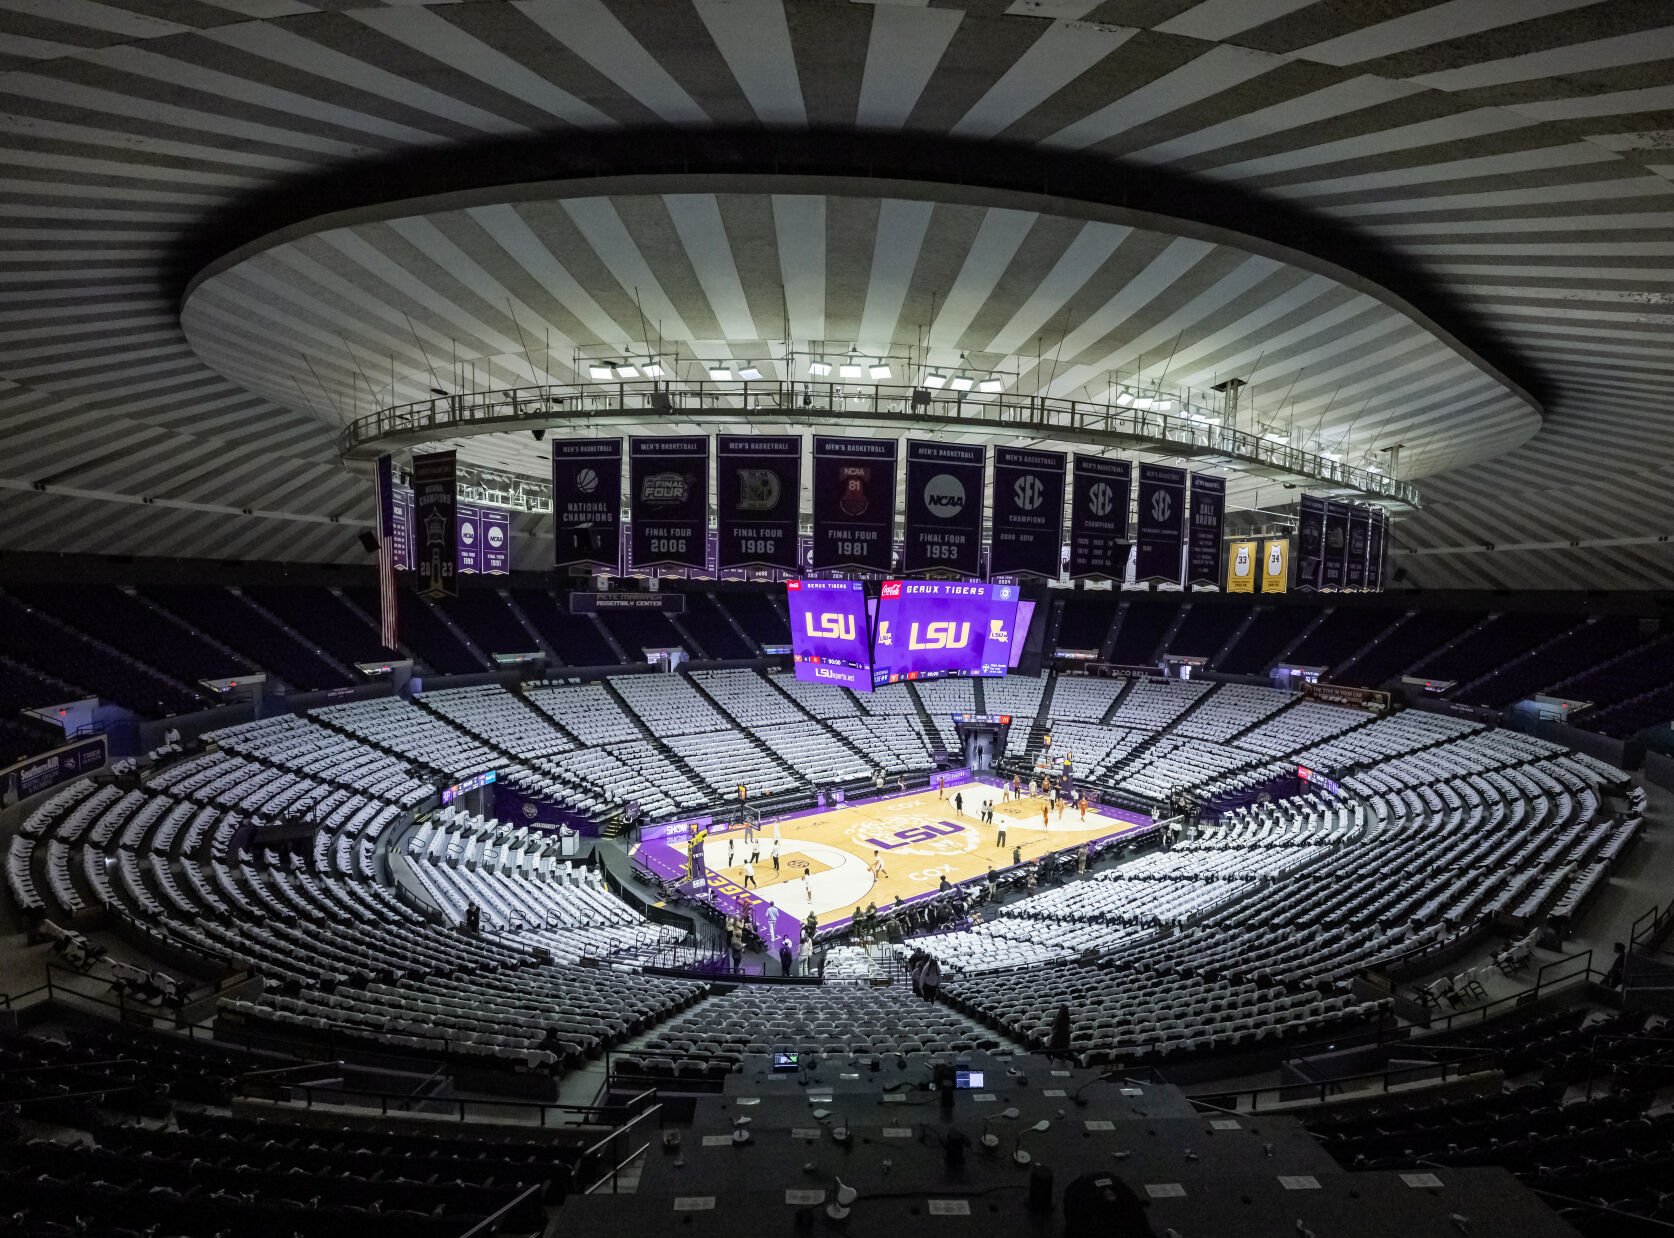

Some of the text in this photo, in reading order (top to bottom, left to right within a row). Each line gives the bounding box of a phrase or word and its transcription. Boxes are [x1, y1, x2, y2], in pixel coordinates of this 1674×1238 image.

[563, 445, 612, 453] MEN'S BASKETBALL
[729, 442, 789, 450] MEN'S BASKETBALL
[826, 444, 885, 453] MEN'S BASKETBALL
[918, 447, 974, 459] MEN'S BASKETBALL
[844, 467, 865, 476] NCAA
[655, 480, 684, 488] FINAL
[848, 480, 860, 491] 81
[645, 488, 683, 497] FOUR
[1014, 475, 1044, 510] SEC
[928, 495, 964, 507] NCAA
[1088, 482, 1113, 516] SEC
[567, 502, 608, 512] NATIONAL
[1152, 489, 1172, 523] SEC
[563, 512, 613, 522] CHAMPIONS
[1008, 514, 1046, 524] CHAMPIONS
[645, 528, 692, 537] FINAL FOUR
[733, 528, 783, 538] FINAL FOUR
[828, 530, 878, 540] FINAL FOUR
[920, 533, 966, 544] FINAL FOUR
[650, 539, 687, 553] 2006
[741, 540, 775, 554] 1986
[837, 542, 868, 556] 1981
[926, 544, 958, 559] 1953
[1238, 556, 1247, 564] 33
[1272, 555, 1280, 563] 34
[420, 562, 453, 577] 20 23
[906, 585, 985, 595] GEAUX TIGERS
[806, 612, 856, 640] LSU
[908, 622, 971, 650] LSU
[816, 668, 855, 682] LSUsports.net
[1132, 670, 1148, 678] BELL
[20, 756, 59, 780] SouthernAIR
[888, 800, 928, 810] COX
[666, 822, 688, 835] SHOW
[864, 820, 966, 850] LSU
[908, 864, 960, 882] COX
